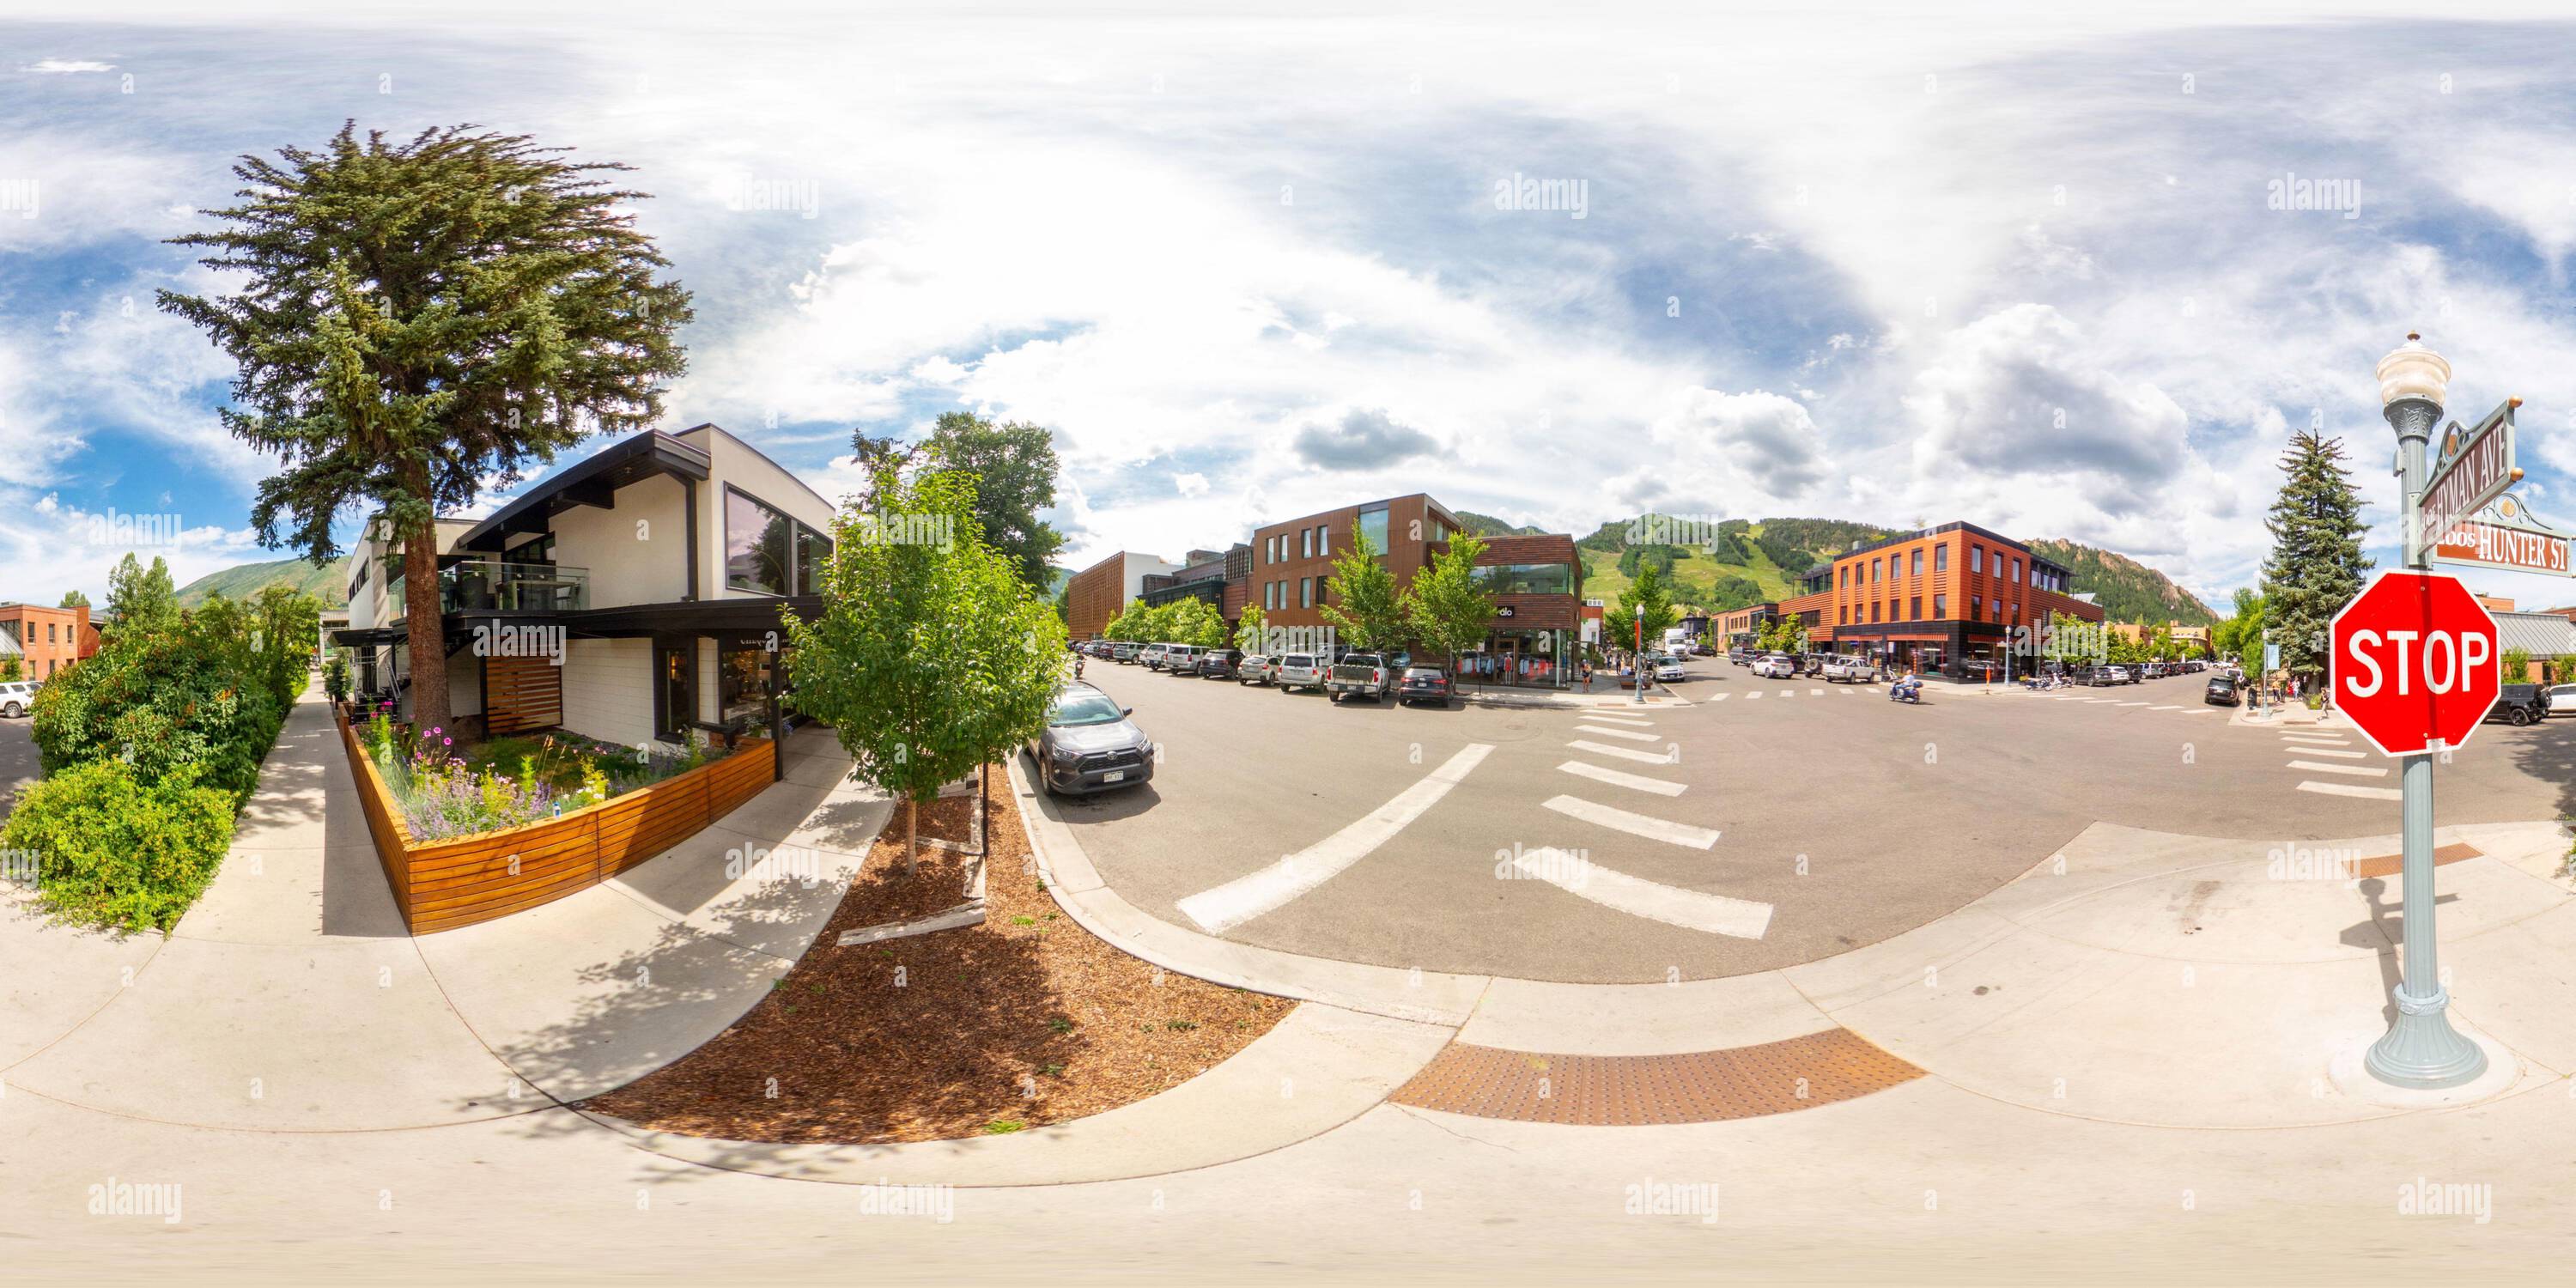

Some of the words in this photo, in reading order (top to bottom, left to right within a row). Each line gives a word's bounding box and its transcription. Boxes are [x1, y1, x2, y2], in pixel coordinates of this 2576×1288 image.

[2437, 449, 2476, 531] HYMAN
[2480, 422, 2506, 493] AVE
[2478, 526, 2546, 567] HUNTER
[2551, 538, 2567, 570] ST
[2346, 629, 2490, 698] STOP
